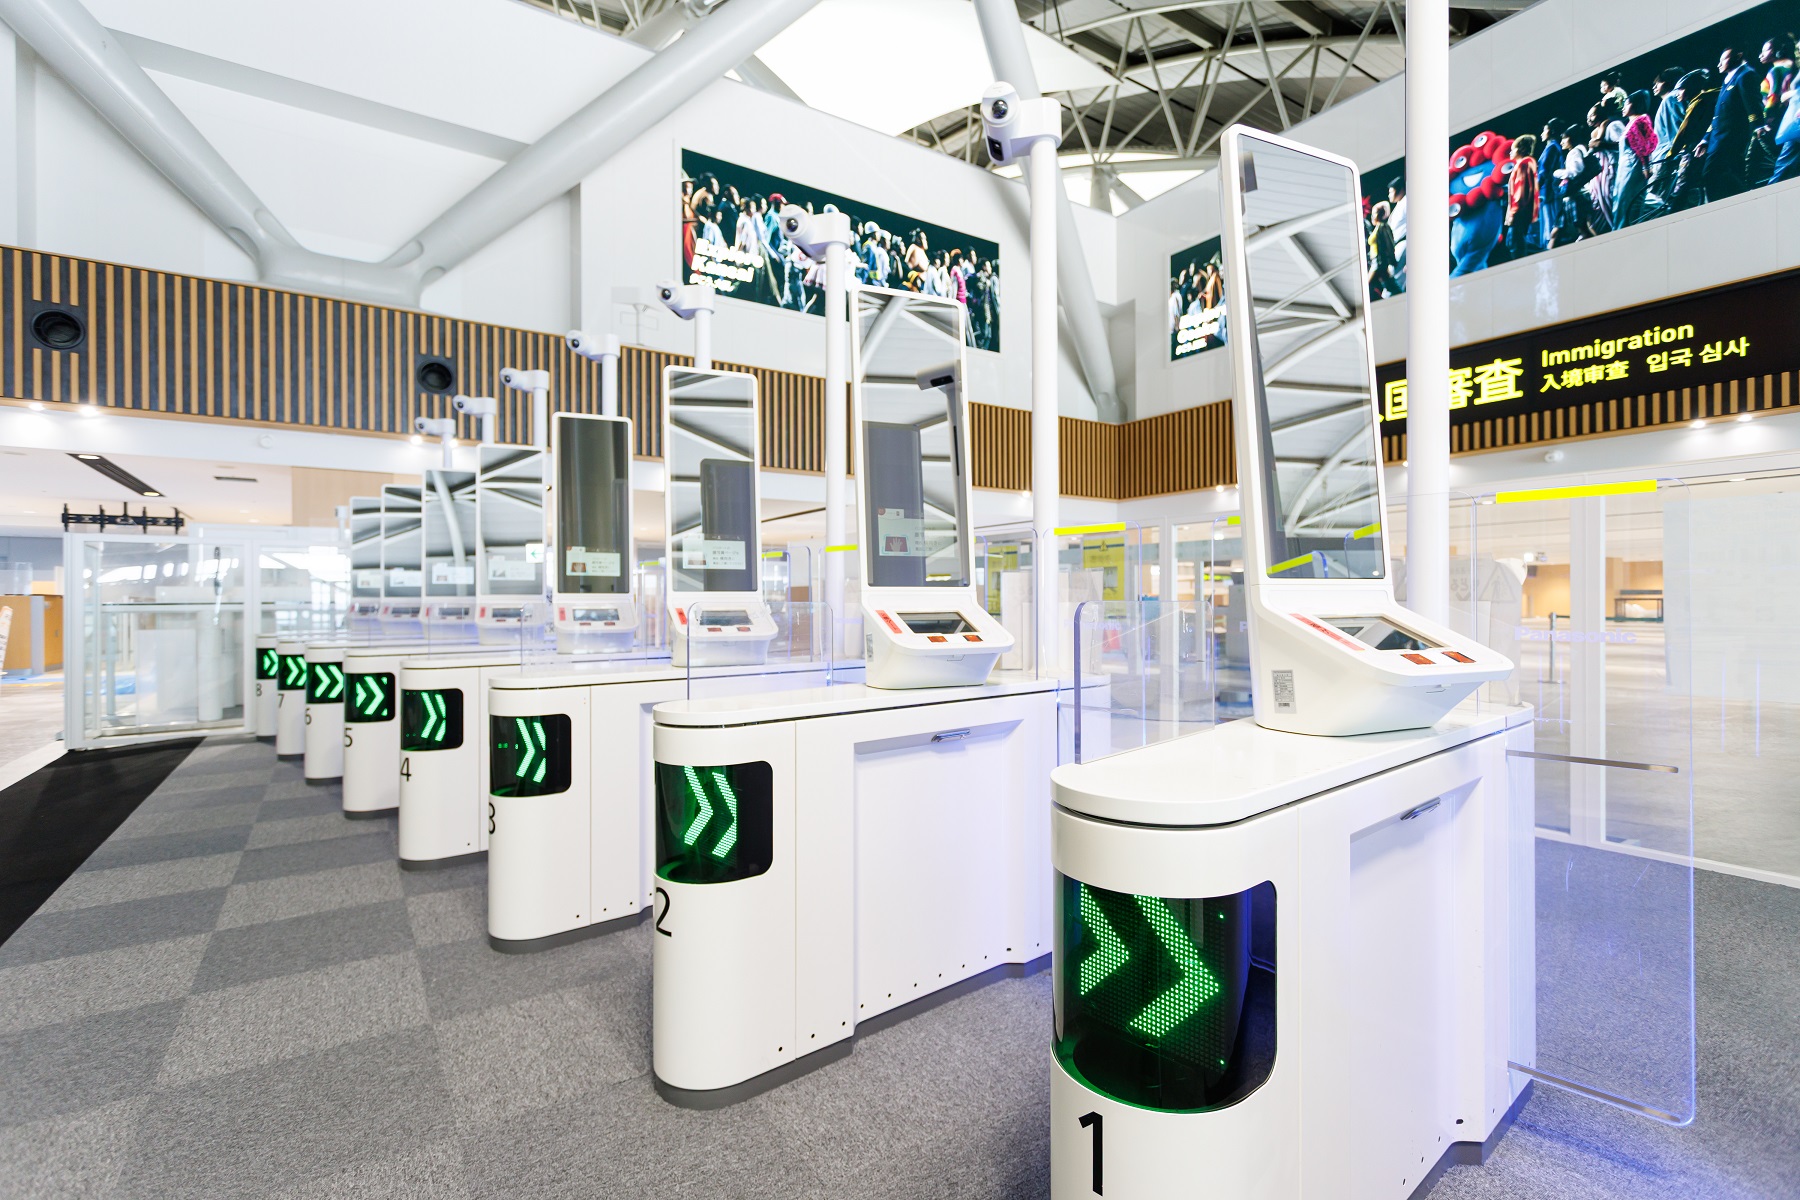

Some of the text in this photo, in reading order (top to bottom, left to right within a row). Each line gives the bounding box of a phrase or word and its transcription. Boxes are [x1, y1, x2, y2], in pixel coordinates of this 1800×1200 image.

[1541, 324, 1694, 368] Immigration
[1646, 336, 1750, 373] 입국 심사
[1378, 357, 1524, 423] 国審査
[1514, 625, 1637, 644] Panasonic
[277, 693, 285, 708] 7
[344, 727, 353, 748] 5
[400, 757, 412, 782] 4
[655, 886, 672, 938] 2
[1078, 1110, 1104, 1197] 1
